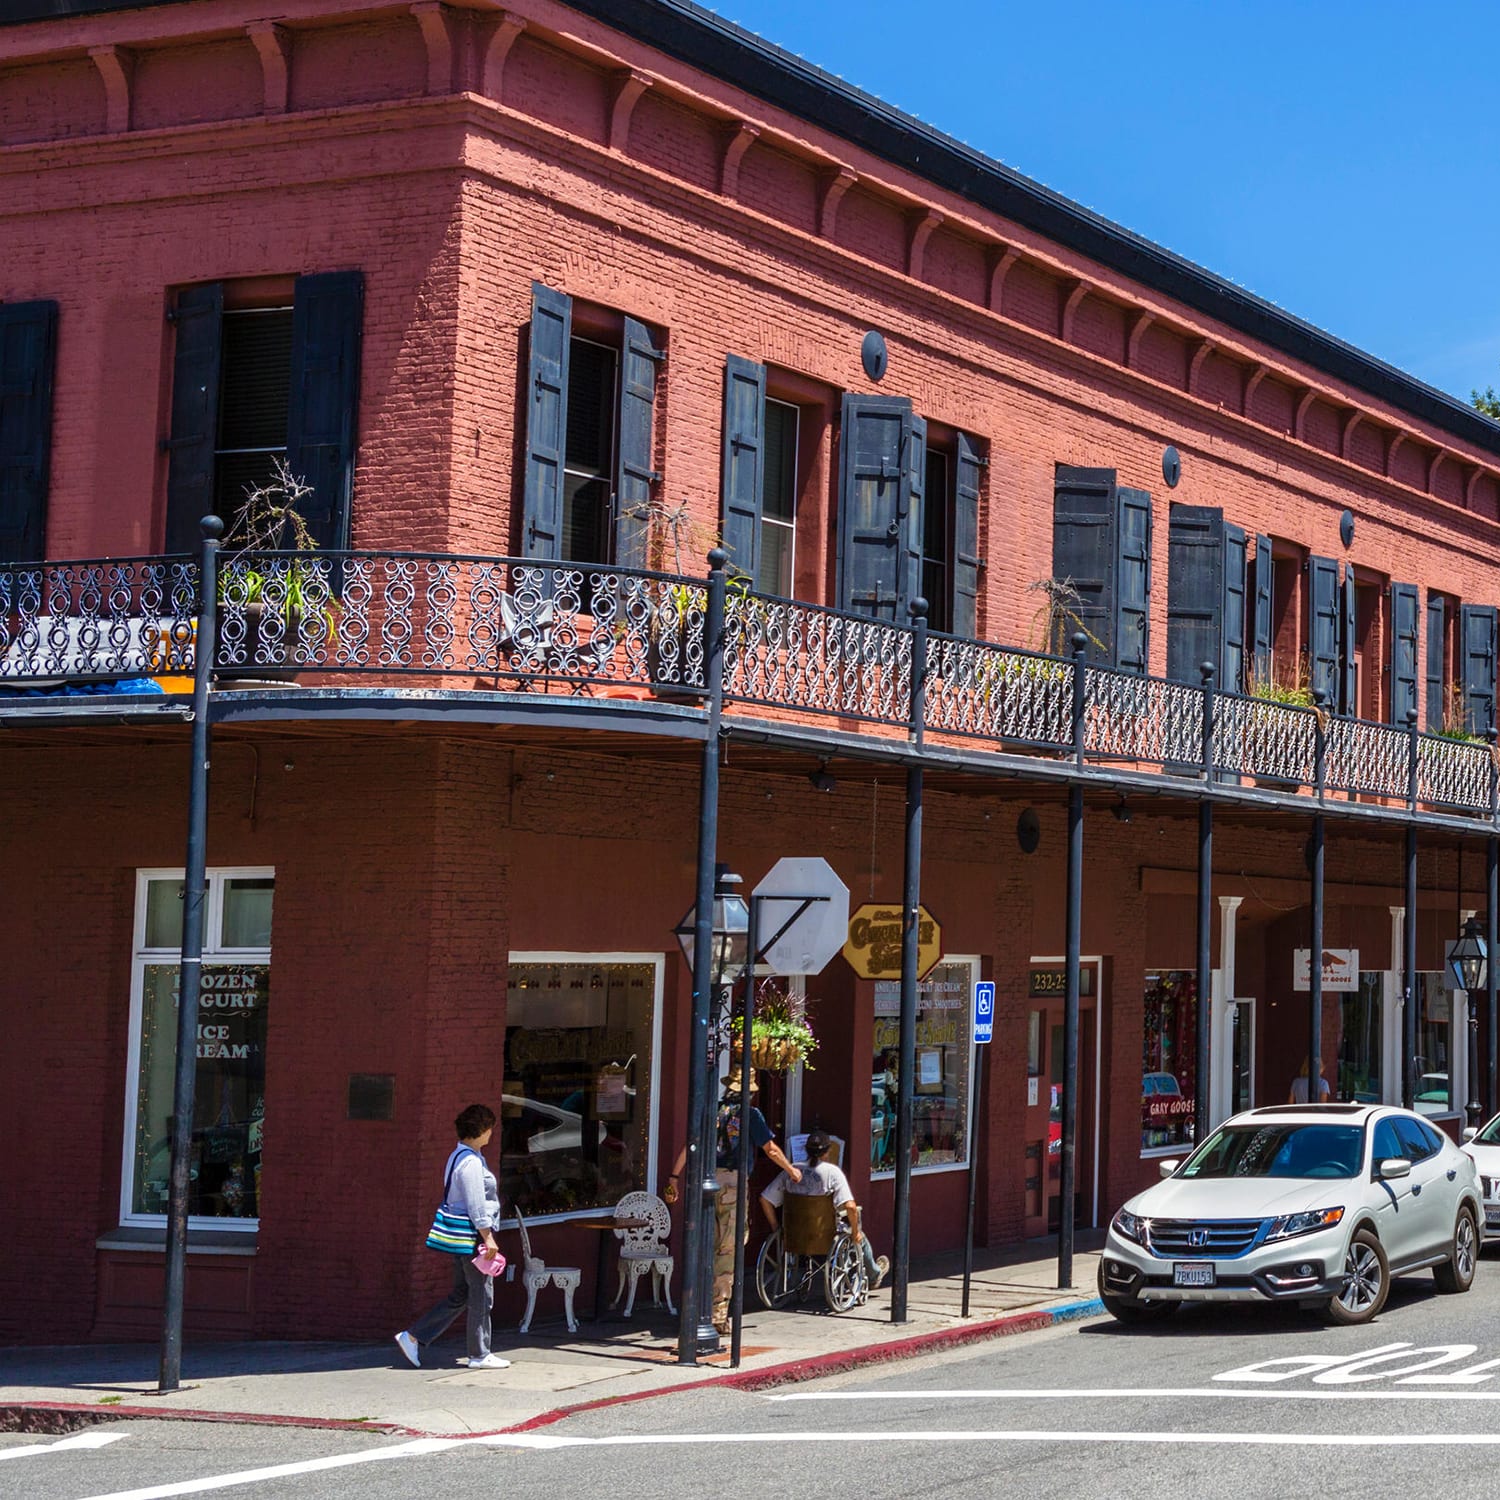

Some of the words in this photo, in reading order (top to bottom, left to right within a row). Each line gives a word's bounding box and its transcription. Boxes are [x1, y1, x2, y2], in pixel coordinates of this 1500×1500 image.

[196, 1023, 230, 1040] ICE
[975, 1023, 992, 1035] PARKING
[1150, 1102, 1168, 1115] GRAY
[1170, 1099, 1195, 1114] GOOSE
[1176, 1270, 1212, 1281] 7BKU153
